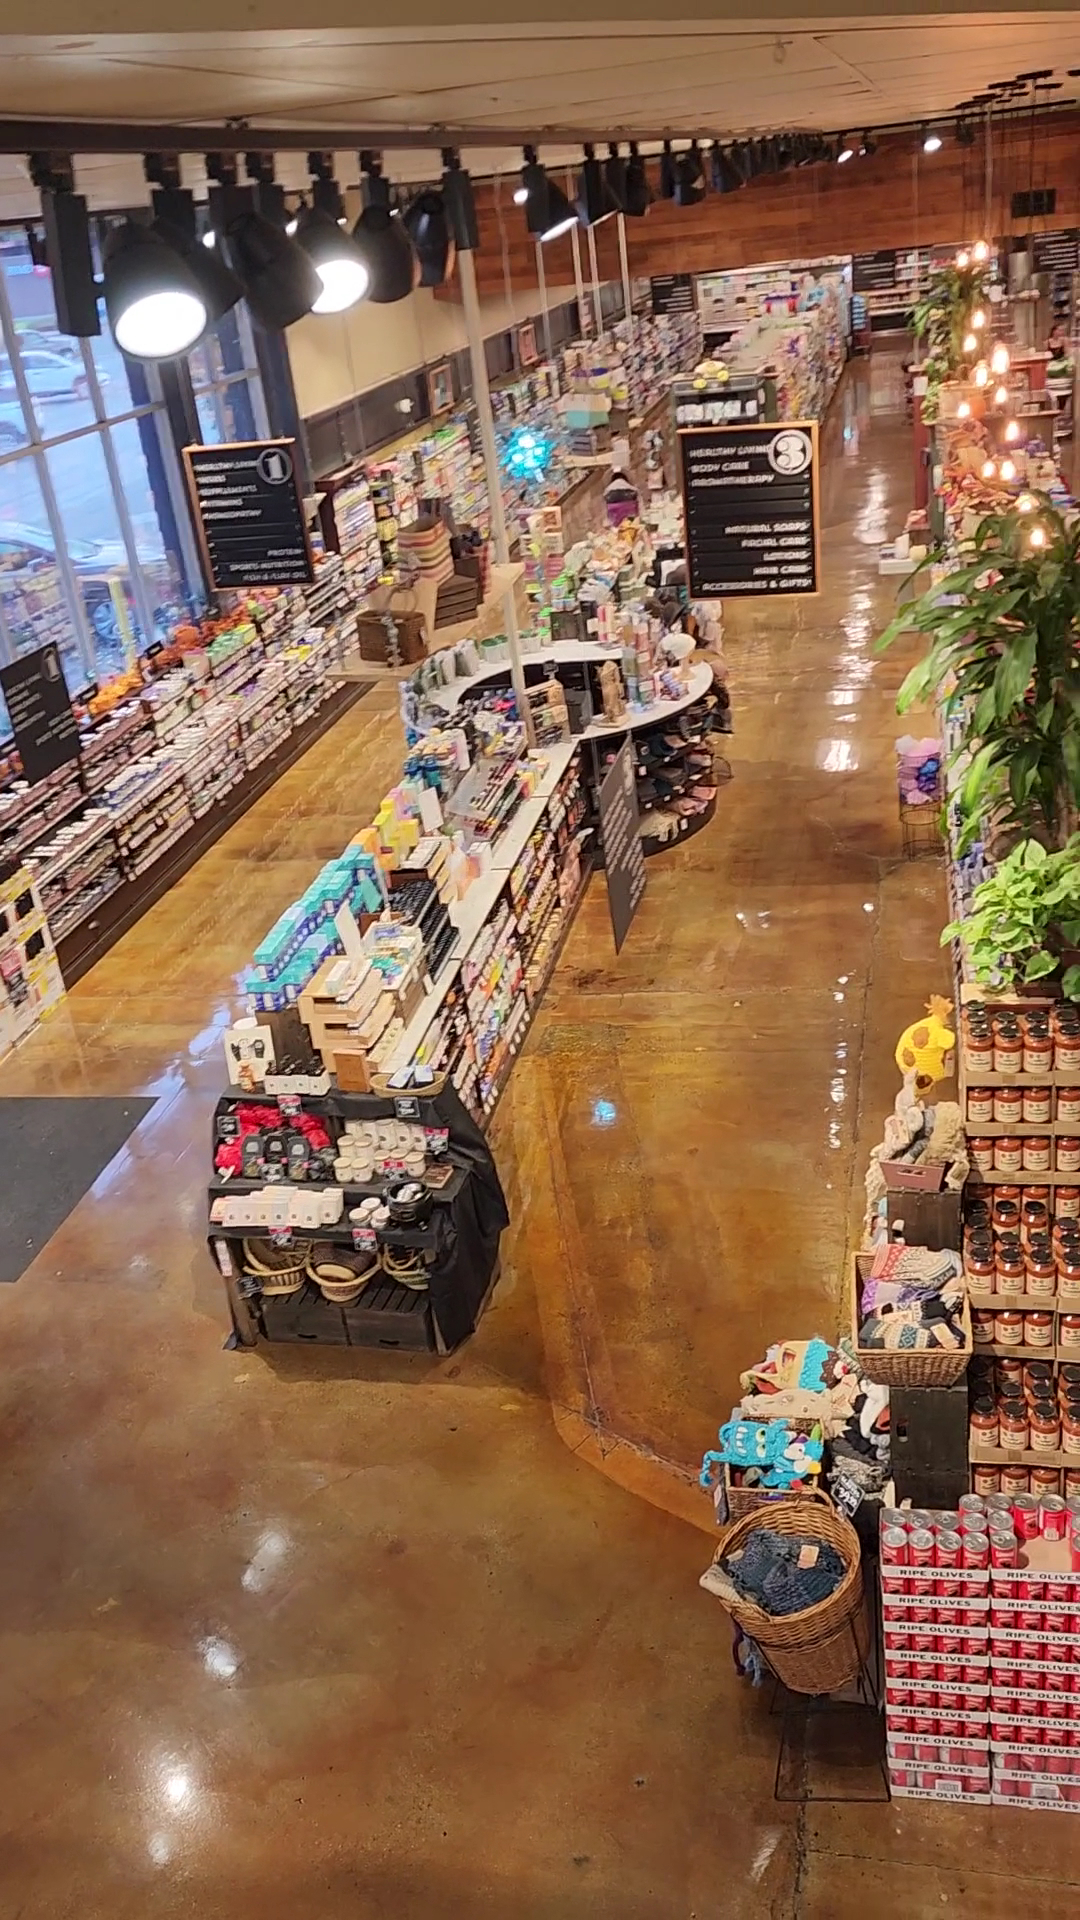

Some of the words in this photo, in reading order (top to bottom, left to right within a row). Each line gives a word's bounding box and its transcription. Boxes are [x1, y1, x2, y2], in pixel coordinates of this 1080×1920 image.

[776, 436, 804, 469] 3
[264, 454, 284, 480] 1
[691, 464, 720, 473] BODY
[721, 461, 750, 471] CARE
[929, 1627, 971, 1635] OLIVES
[1037, 1634, 1079, 1643] OLIVES
[931, 1655, 971, 1663] OLIVES
[1038, 1664, 1080, 1672] OLIVES
[932, 1684, 972, 1692] OLIVES
[1038, 1693, 1080, 1701] OLIVES
[931, 1711, 971, 1719] OLIVES
[1007, 1716, 1034, 1724] RIPE
[1038, 1719, 1080, 1728] OLIVES
[934, 1738, 974, 1746] OLIVES
[1039, 1747, 1080, 1755] OLIVES
[934, 1765, 973, 1773] OLIVES
[936, 1792, 976, 1801] OLIVES
[1008, 1798, 1035, 1806] RIPE
[1038, 1801, 1079, 1809] OLIVES
